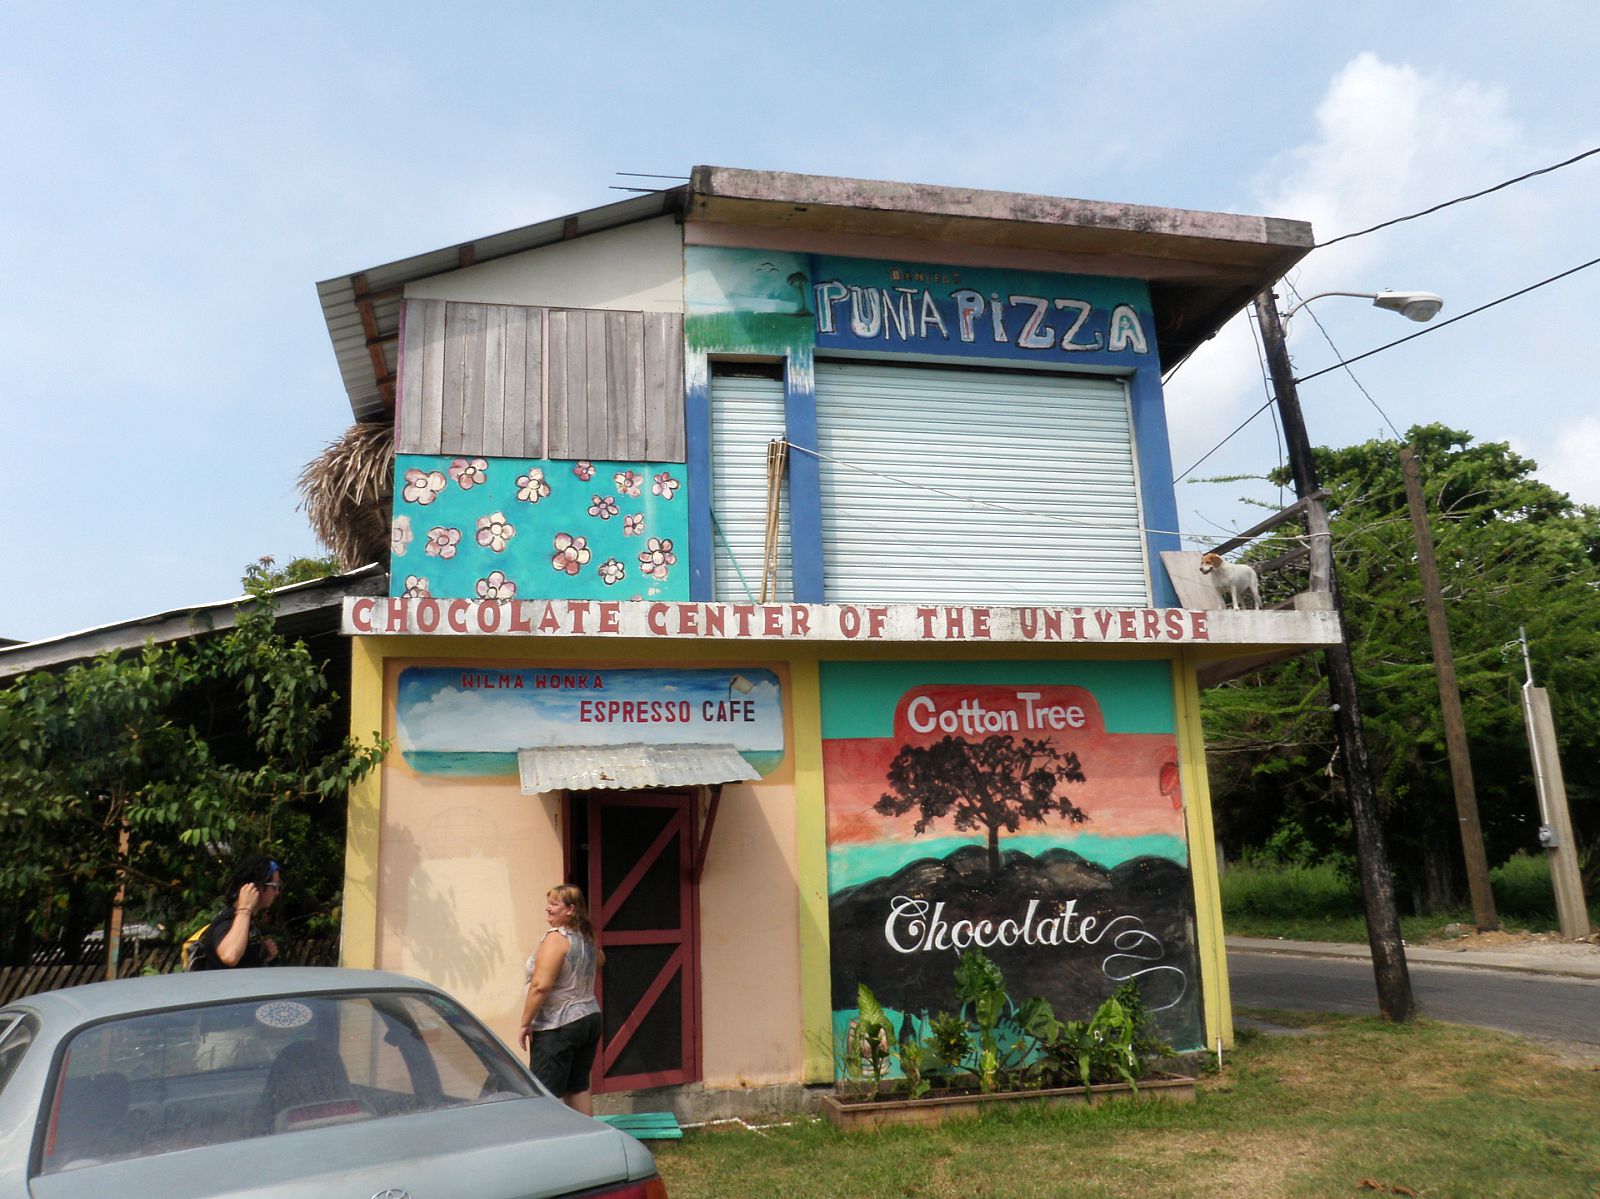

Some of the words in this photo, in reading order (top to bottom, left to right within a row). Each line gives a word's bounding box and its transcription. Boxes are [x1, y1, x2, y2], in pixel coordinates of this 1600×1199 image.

[814, 280, 949, 341] PUNTA
[352, 599, 621, 634] CHOCOLATE
[648, 603, 811, 637] CENTER
[840, 607, 888, 638] OF
[917, 608, 991, 639] THE
[461, 673, 524, 689] WILMA
[535, 674, 604, 689] WONKA
[580, 700, 691, 723] ESPRESSO
[702, 700, 756, 723] CAFE
[907, 695, 1018, 735] Cotton
[1017, 691, 1085, 730] Tree
[884, 895, 1104, 954] Chocolate
